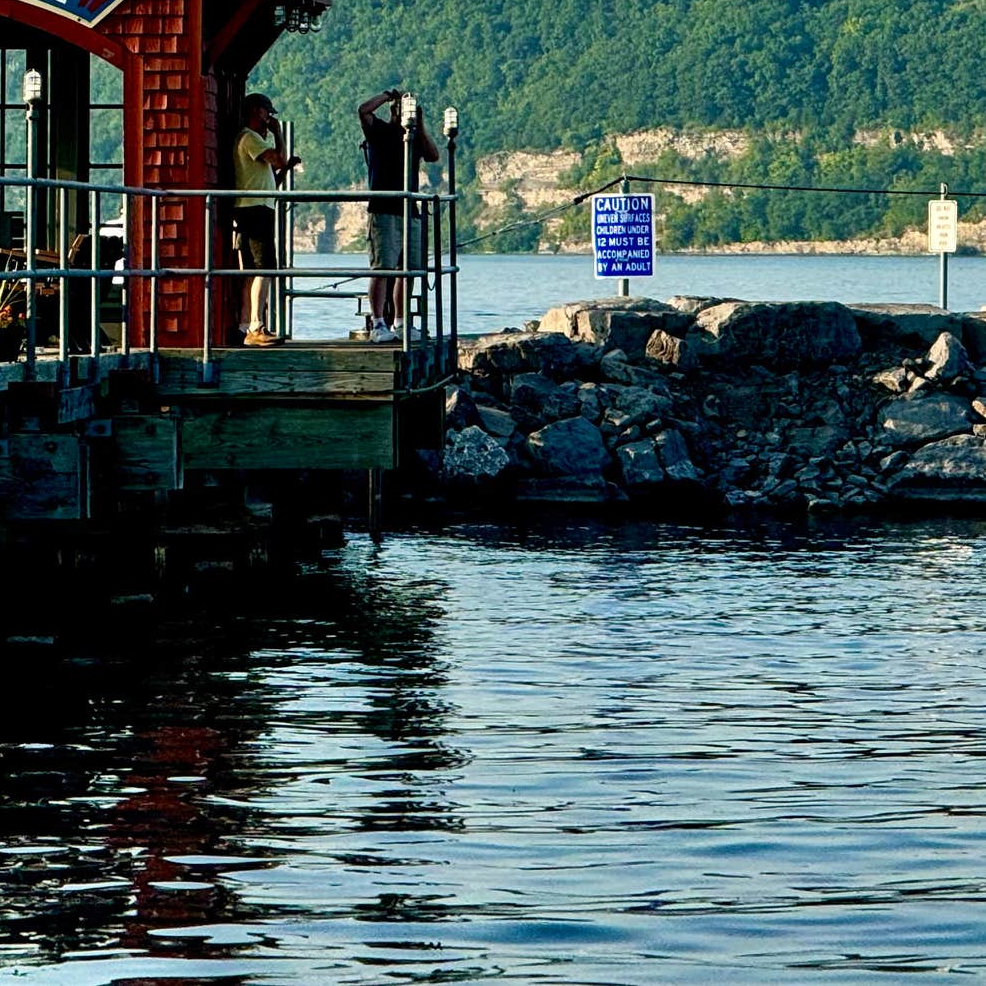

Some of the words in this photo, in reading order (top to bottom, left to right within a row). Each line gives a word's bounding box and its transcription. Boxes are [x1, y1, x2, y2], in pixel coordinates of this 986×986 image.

[596, 198, 649, 212] CAUTION
[619, 213, 650, 223] SURFACES
[596, 225, 626, 235] CHILDREN
[627, 225, 650, 234] UNDER
[597, 237, 607, 247] 12
[608, 237, 634, 246] MUST
[637, 236, 650, 246] BE
[597, 249, 650, 259] ACCOMPANIED
[598, 262, 609, 272] BY
[611, 262, 623, 271] AN
[625, 261, 651, 271] ADULT
